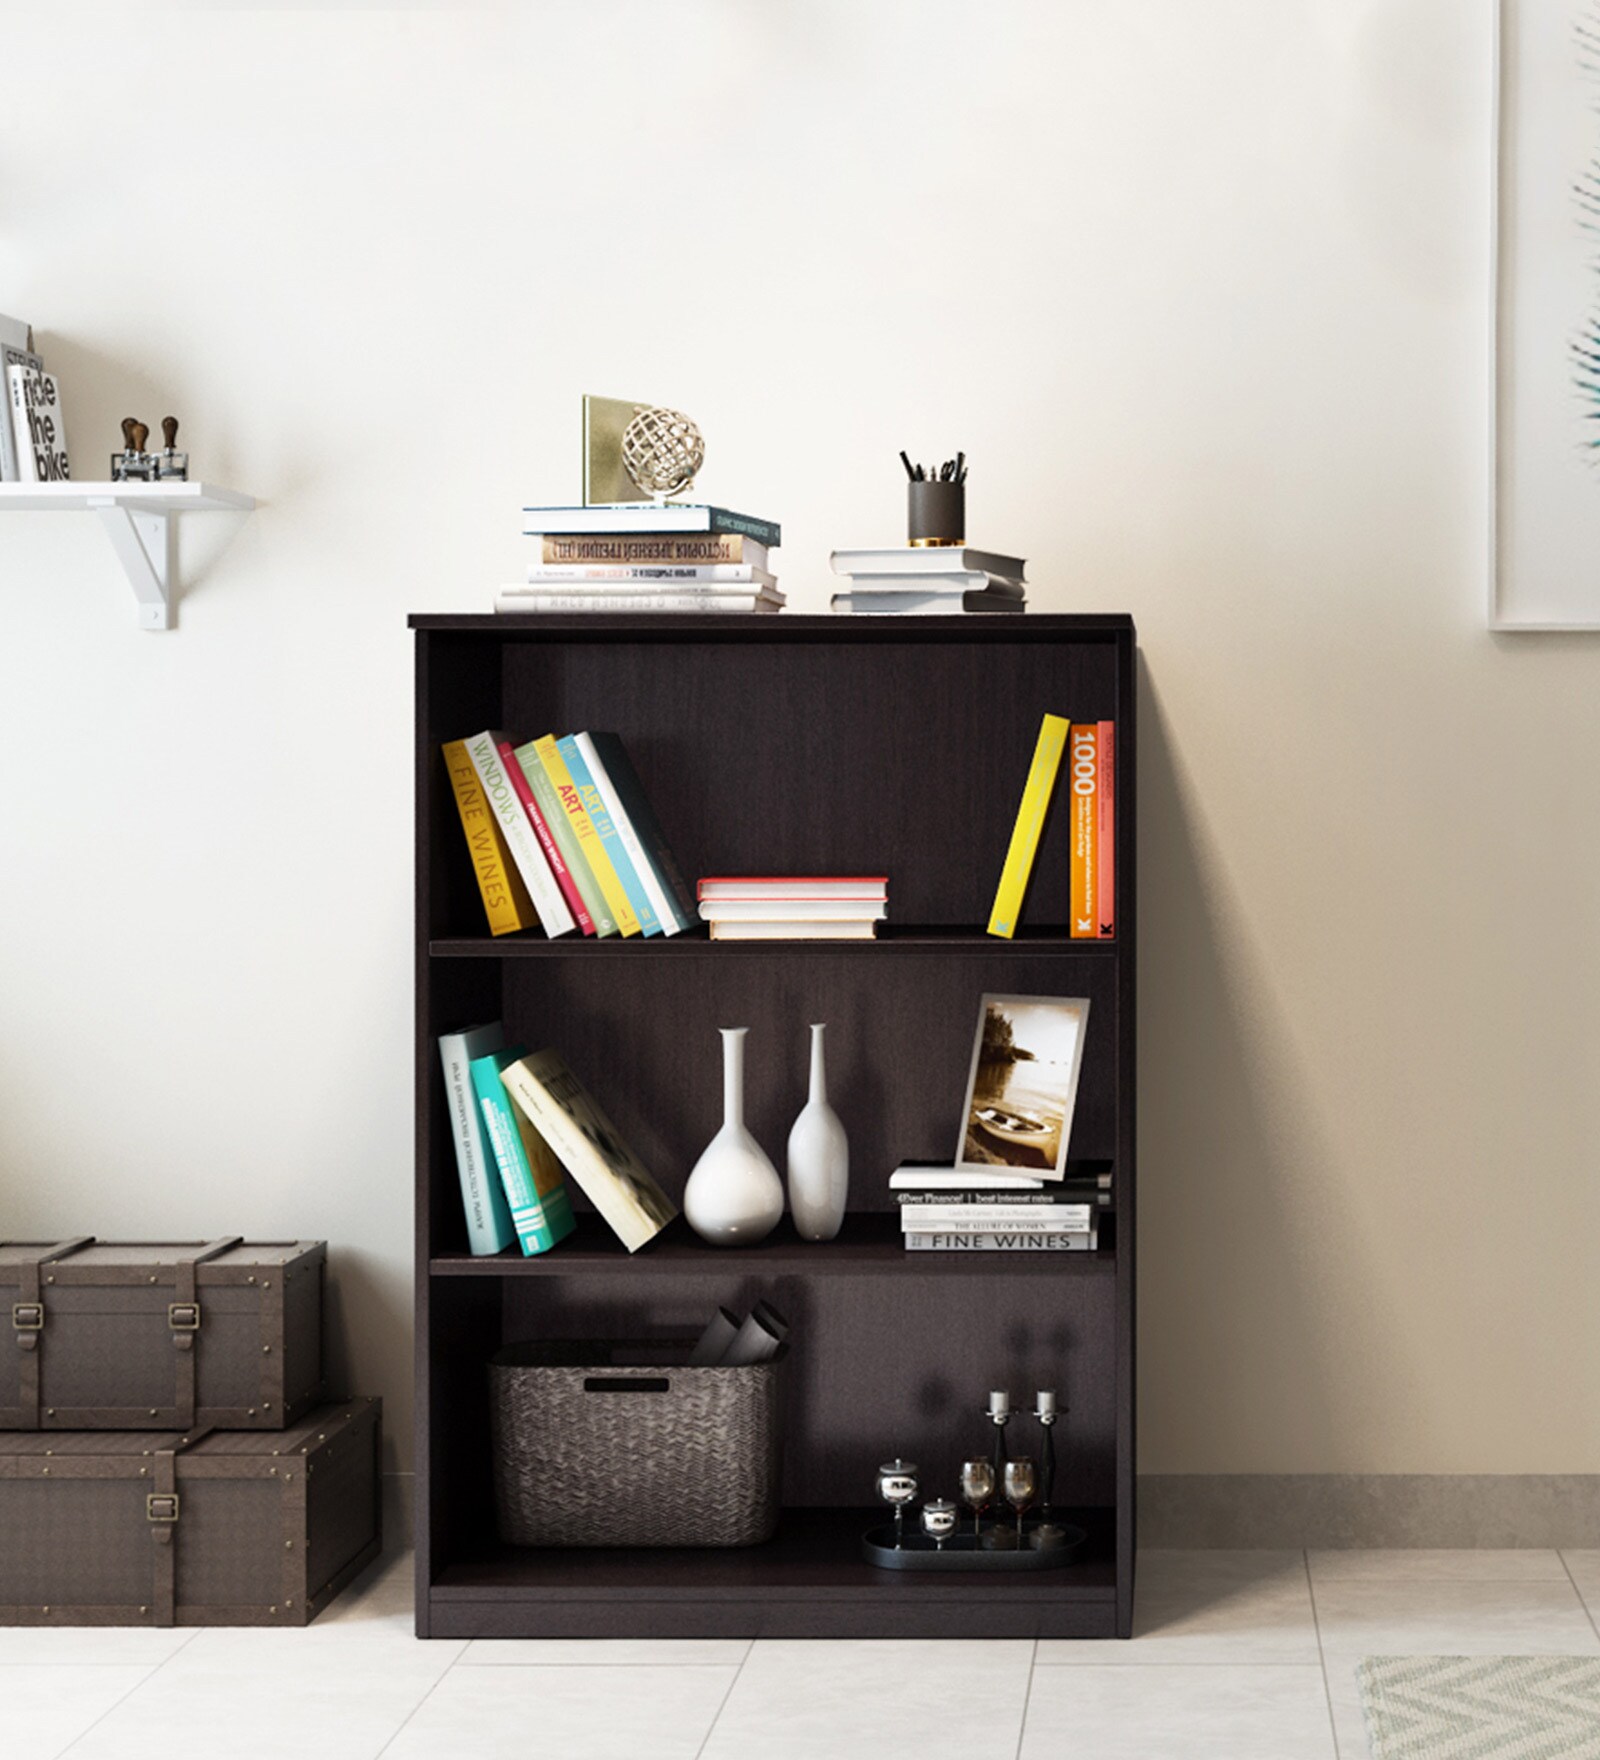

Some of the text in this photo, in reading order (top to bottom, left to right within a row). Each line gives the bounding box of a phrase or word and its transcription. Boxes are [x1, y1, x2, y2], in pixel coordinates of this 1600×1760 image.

[23, 369, 55, 407] ride
[26, 408, 55, 445] the
[34, 445, 70, 482] bike
[473, 739, 520, 825] WINDOWS
[1074, 732, 1096, 795] 1000
[558, 785, 585, 815] ART
[580, 785, 606, 815] ART
[454, 767, 484, 821] FINE
[473, 828, 507, 909] WINES
[976, 1193, 997, 1204] best
[998, 1193, 1031, 1204] interest
[932, 1234, 983, 1248] FINE
[994, 1234, 1071, 1248] WINES
